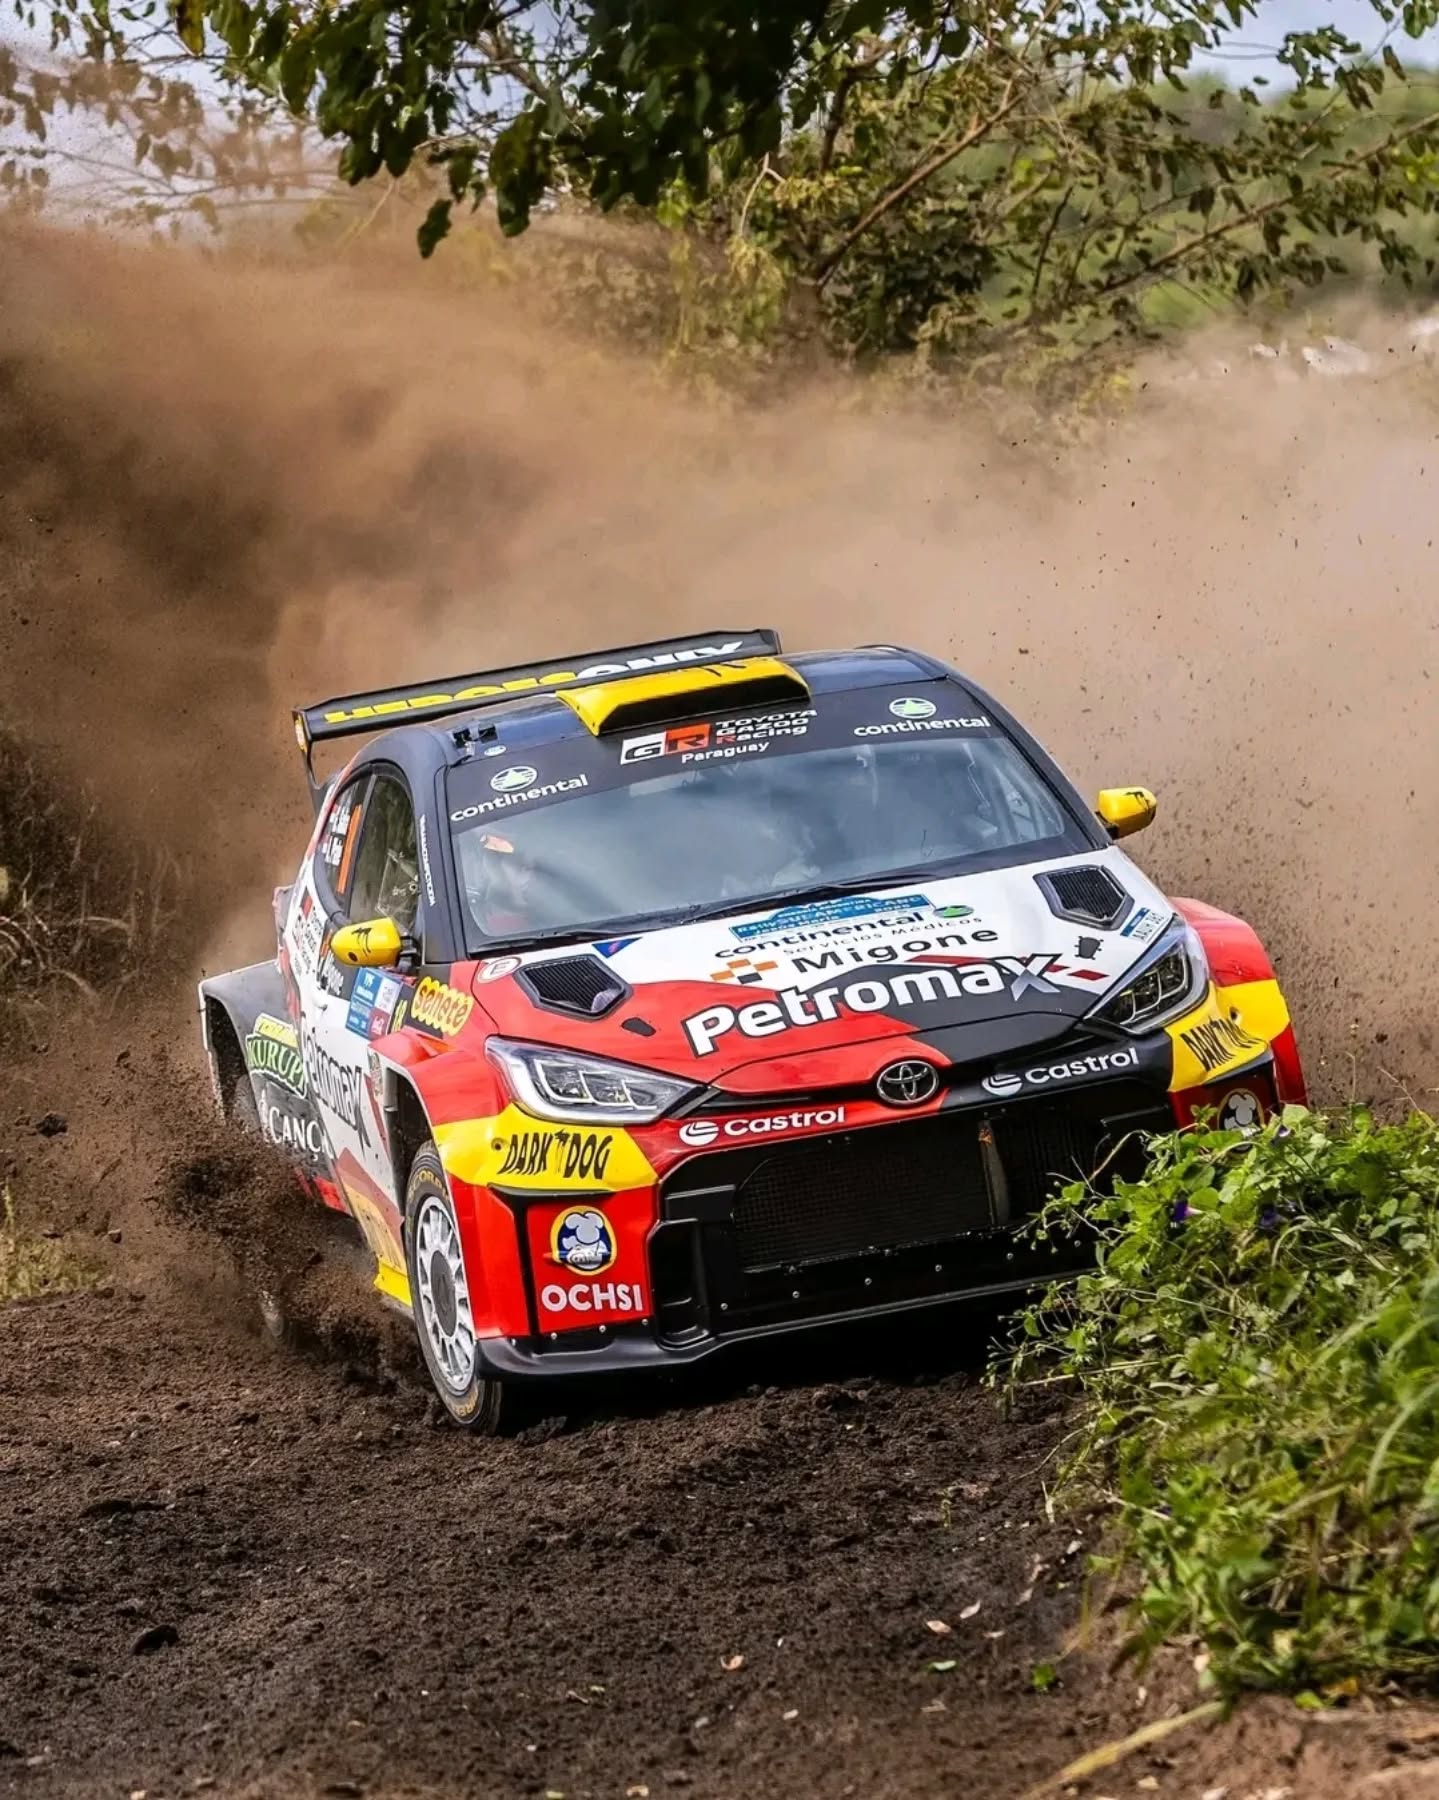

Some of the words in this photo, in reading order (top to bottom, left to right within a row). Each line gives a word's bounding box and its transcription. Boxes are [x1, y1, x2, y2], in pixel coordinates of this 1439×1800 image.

[715, 709, 817, 729] TOYOTA
[716, 718, 809, 736] GAZOO
[853, 716, 991, 737] continental
[622, 726, 710, 764] GR
[716, 725, 807, 745] Racing
[681, 742, 769, 764] Paraguay
[450, 773, 589, 822] continental
[714, 912, 924, 958] continental
[791, 929, 999, 973] Migone
[1021, 1048, 1140, 1086] Castrol
[724, 1106, 846, 1137] Castrol
[498, 1132, 555, 1175] DARK
[564, 1132, 614, 1179] DOG
[541, 1283, 643, 1312] OCHSI
